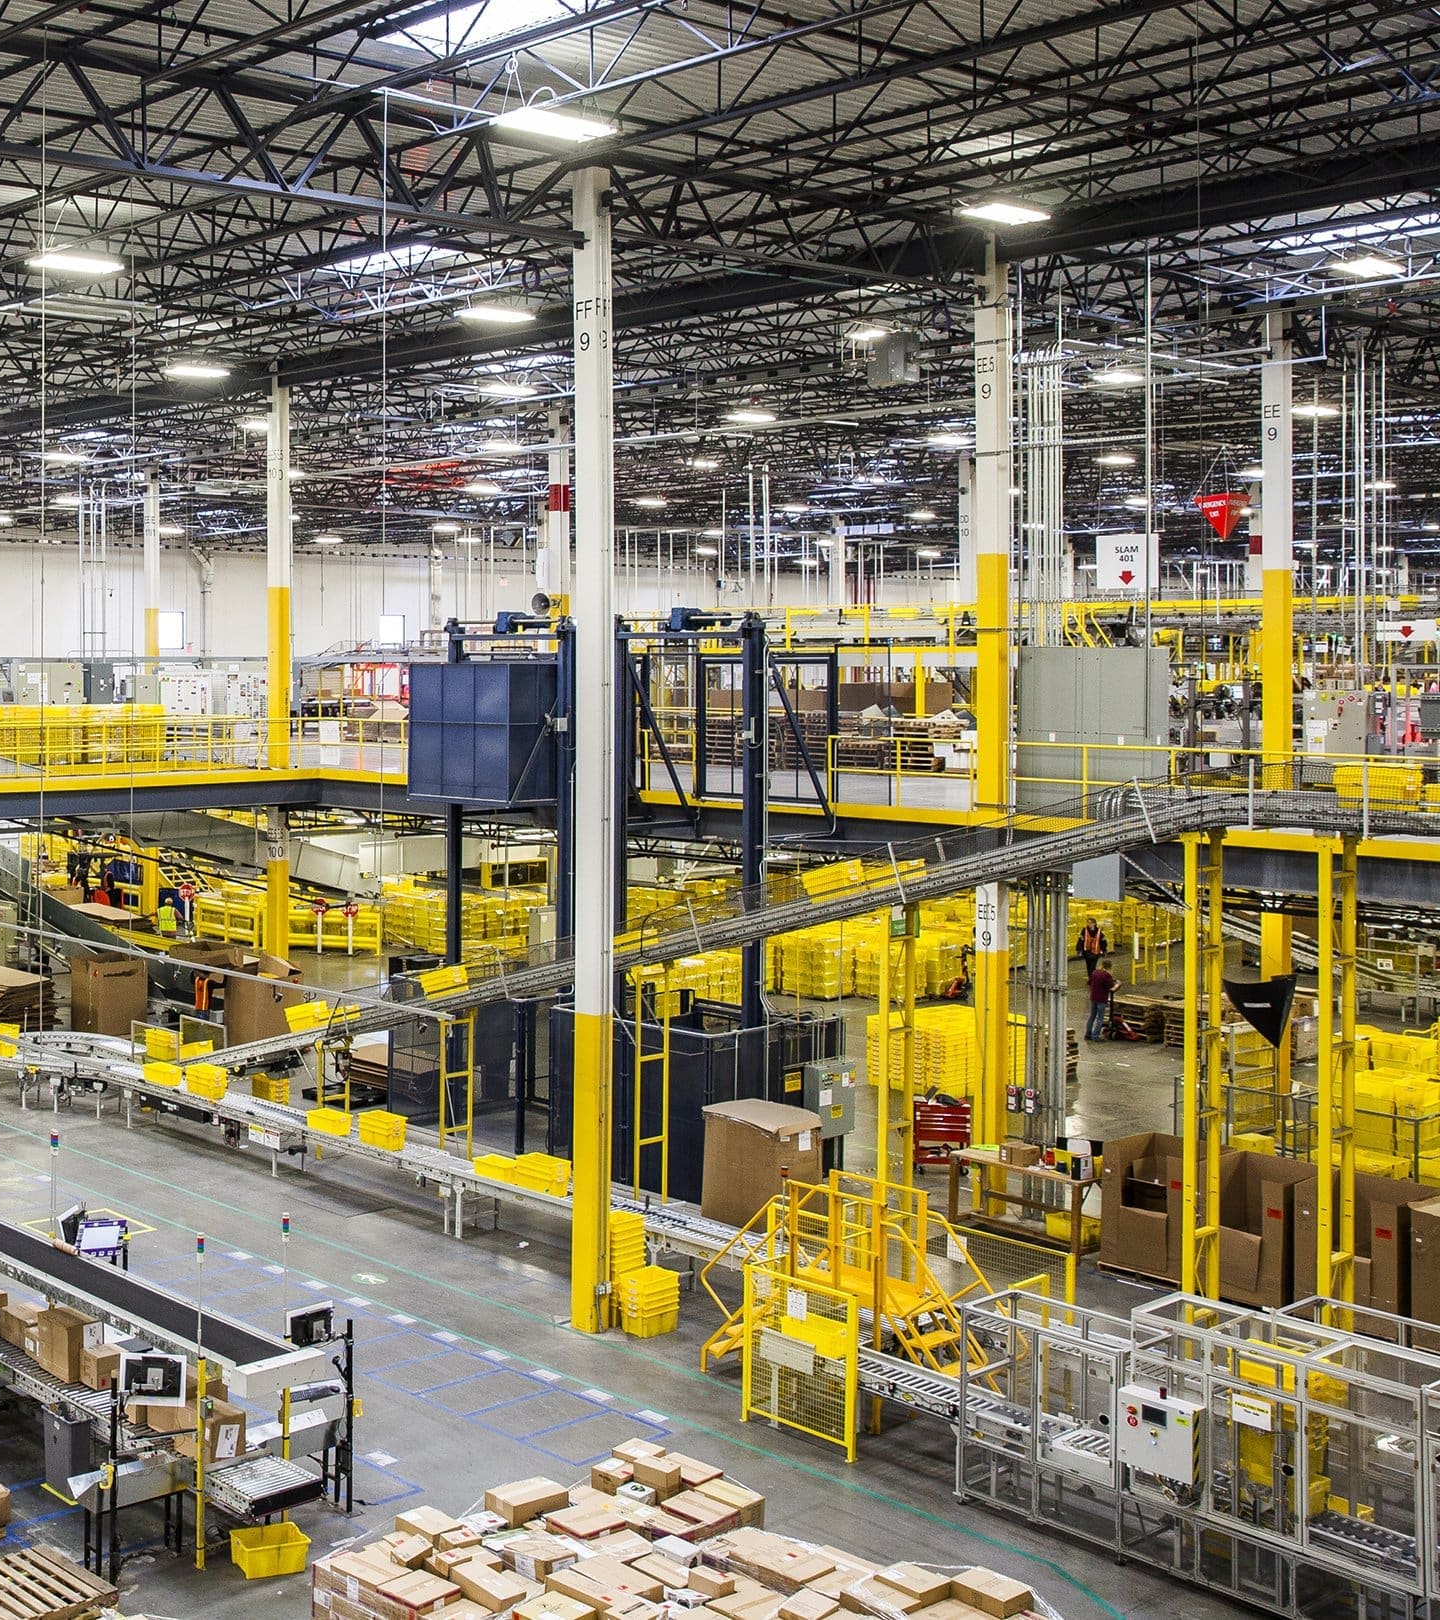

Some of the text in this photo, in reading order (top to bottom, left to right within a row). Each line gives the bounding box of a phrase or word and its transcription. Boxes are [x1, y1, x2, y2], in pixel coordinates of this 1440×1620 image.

[576, 299, 593, 320] FF
[580, 332, 590, 351] 9
[981, 383, 991, 399] 9
[1263, 404, 1281, 419] EE
[1267, 427, 1277, 441] 9
[960, 528, 970, 537] 10
[1114, 545, 1139, 554] SLAM
[1119, 554, 1134, 562] 401
[981, 930, 992, 947] 9
